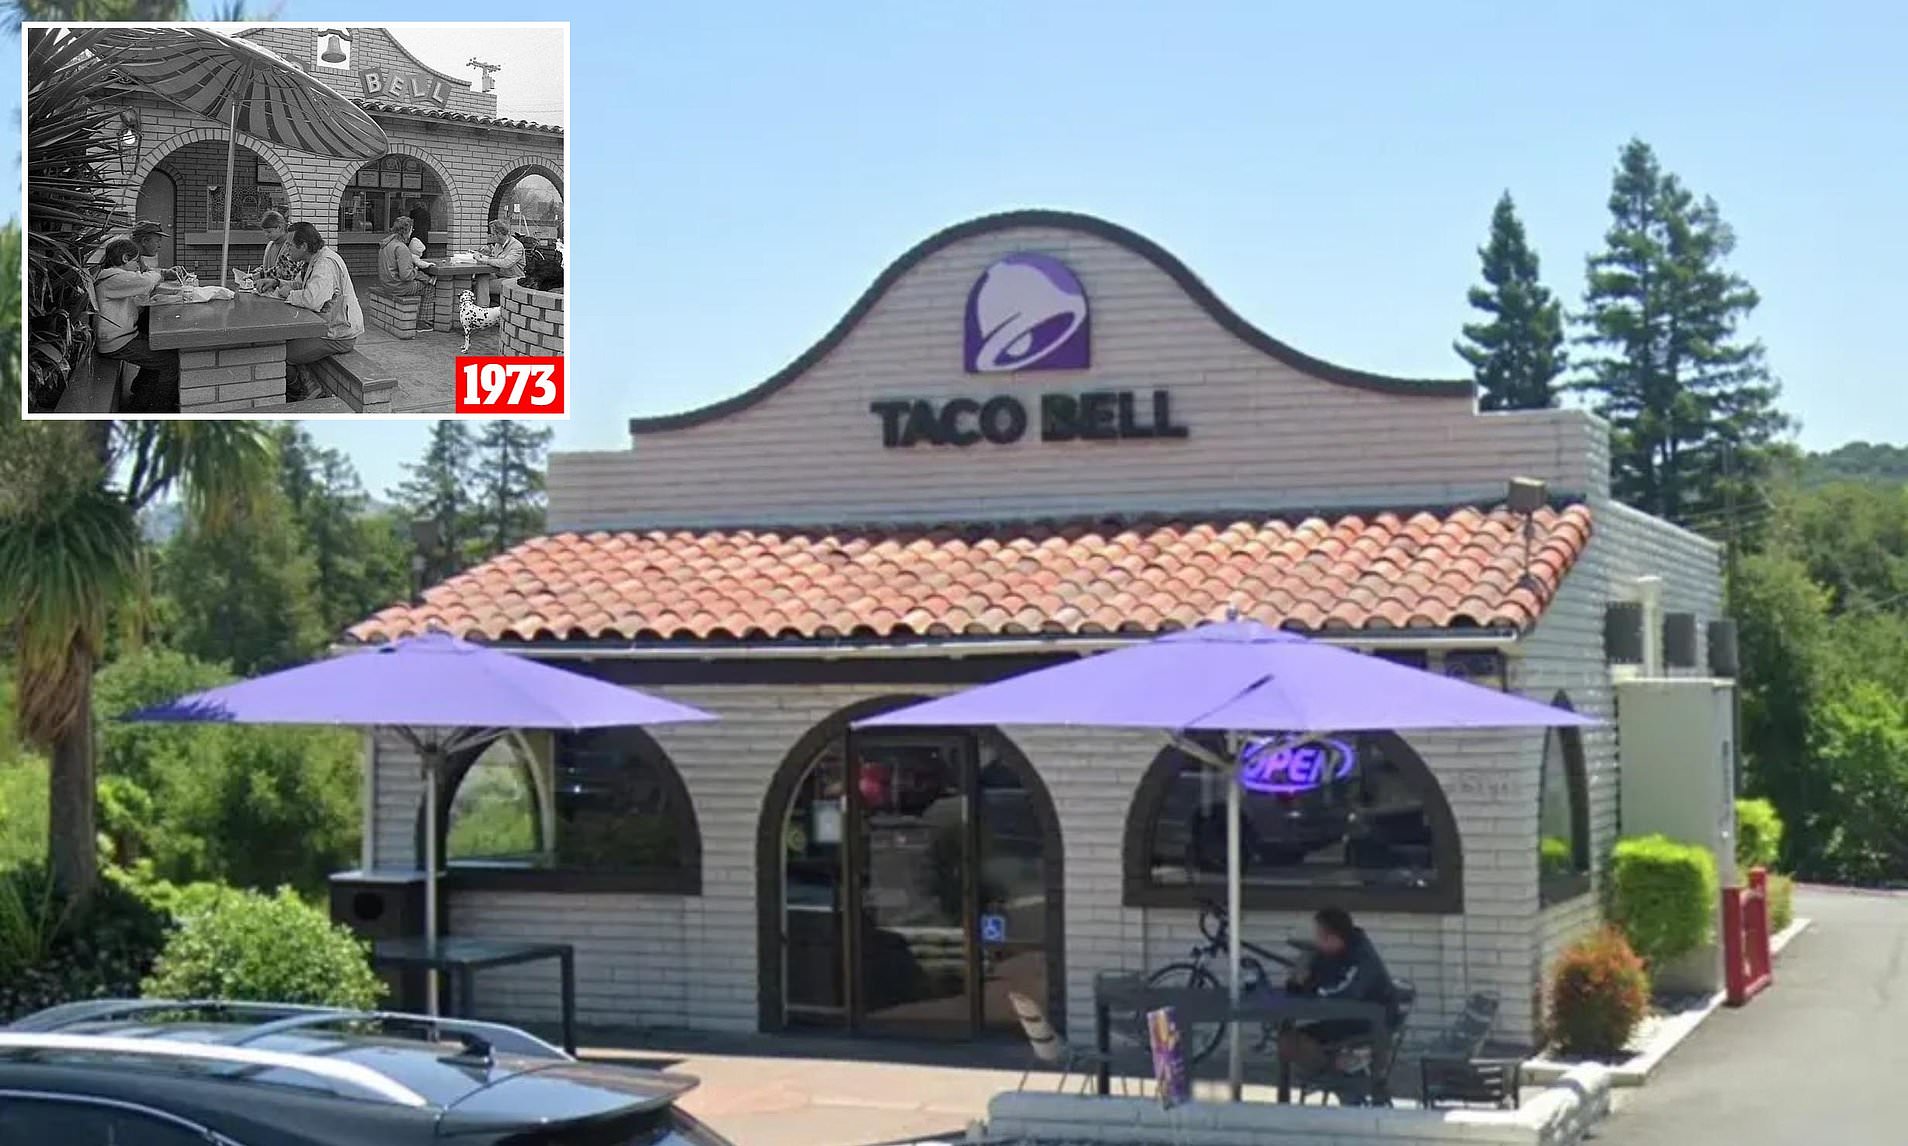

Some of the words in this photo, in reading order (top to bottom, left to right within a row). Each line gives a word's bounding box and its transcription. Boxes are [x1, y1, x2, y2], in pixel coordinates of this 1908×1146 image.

[364, 71, 444, 104] BELL
[869, 395, 1027, 448] TACO
[1041, 390, 1189, 442] BELL
[1242, 744, 1338, 782] OPEN
